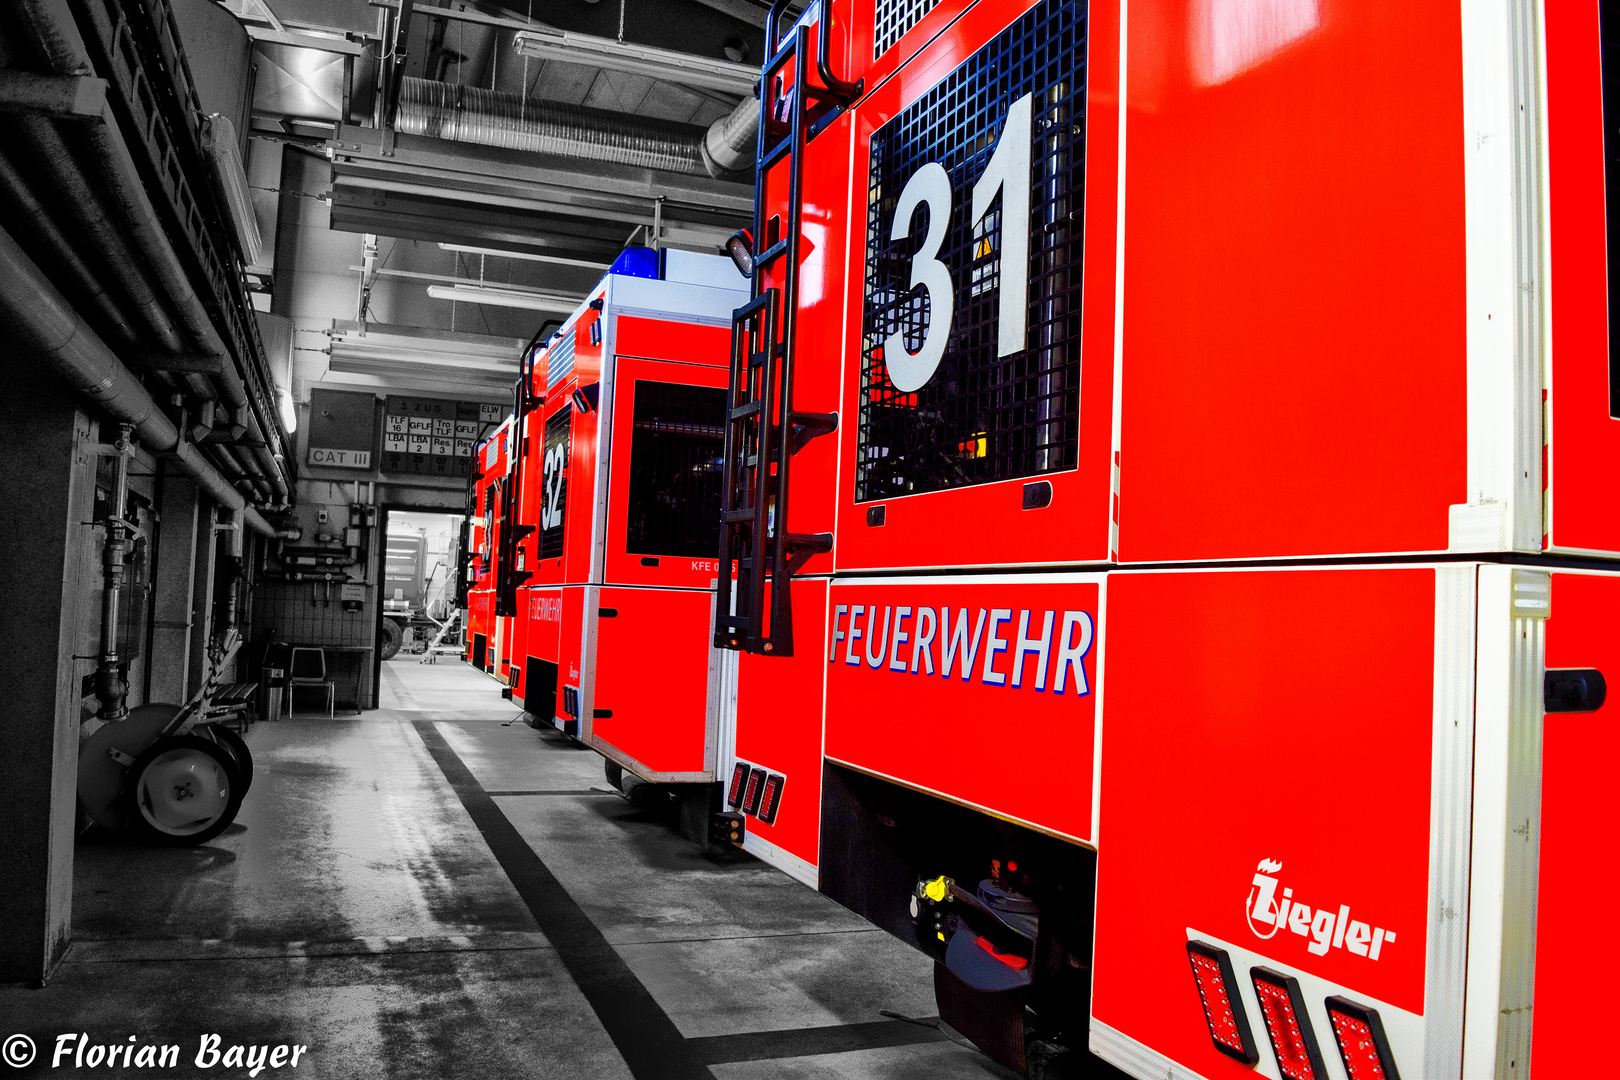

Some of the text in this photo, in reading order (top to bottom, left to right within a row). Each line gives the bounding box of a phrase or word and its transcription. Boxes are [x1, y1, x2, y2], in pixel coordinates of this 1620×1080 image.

[884, 91, 1032, 393] 31
[400, 402, 407, 410] 3
[481, 405, 500, 414] ELW
[390, 416, 406, 424] TLF
[488, 413, 492, 421] 1
[393, 424, 402, 432] 16
[409, 421, 432, 430] GFLF
[437, 419, 451, 428] Tro
[435, 427, 452, 436] TLF
[456, 425, 477, 434] GFLF
[388, 434, 405, 442] LBA
[411, 435, 428, 444] LBA
[434, 438, 452, 447] Res.
[439, 446, 445, 454] 3
[313, 450, 367, 465] CAT III
[542, 442, 565, 531] 32
[691, 561, 711, 571] KFE
[829, 604, 1094, 697] FEUERWEHR
[1247, 868, 1396, 961] Ziegler
